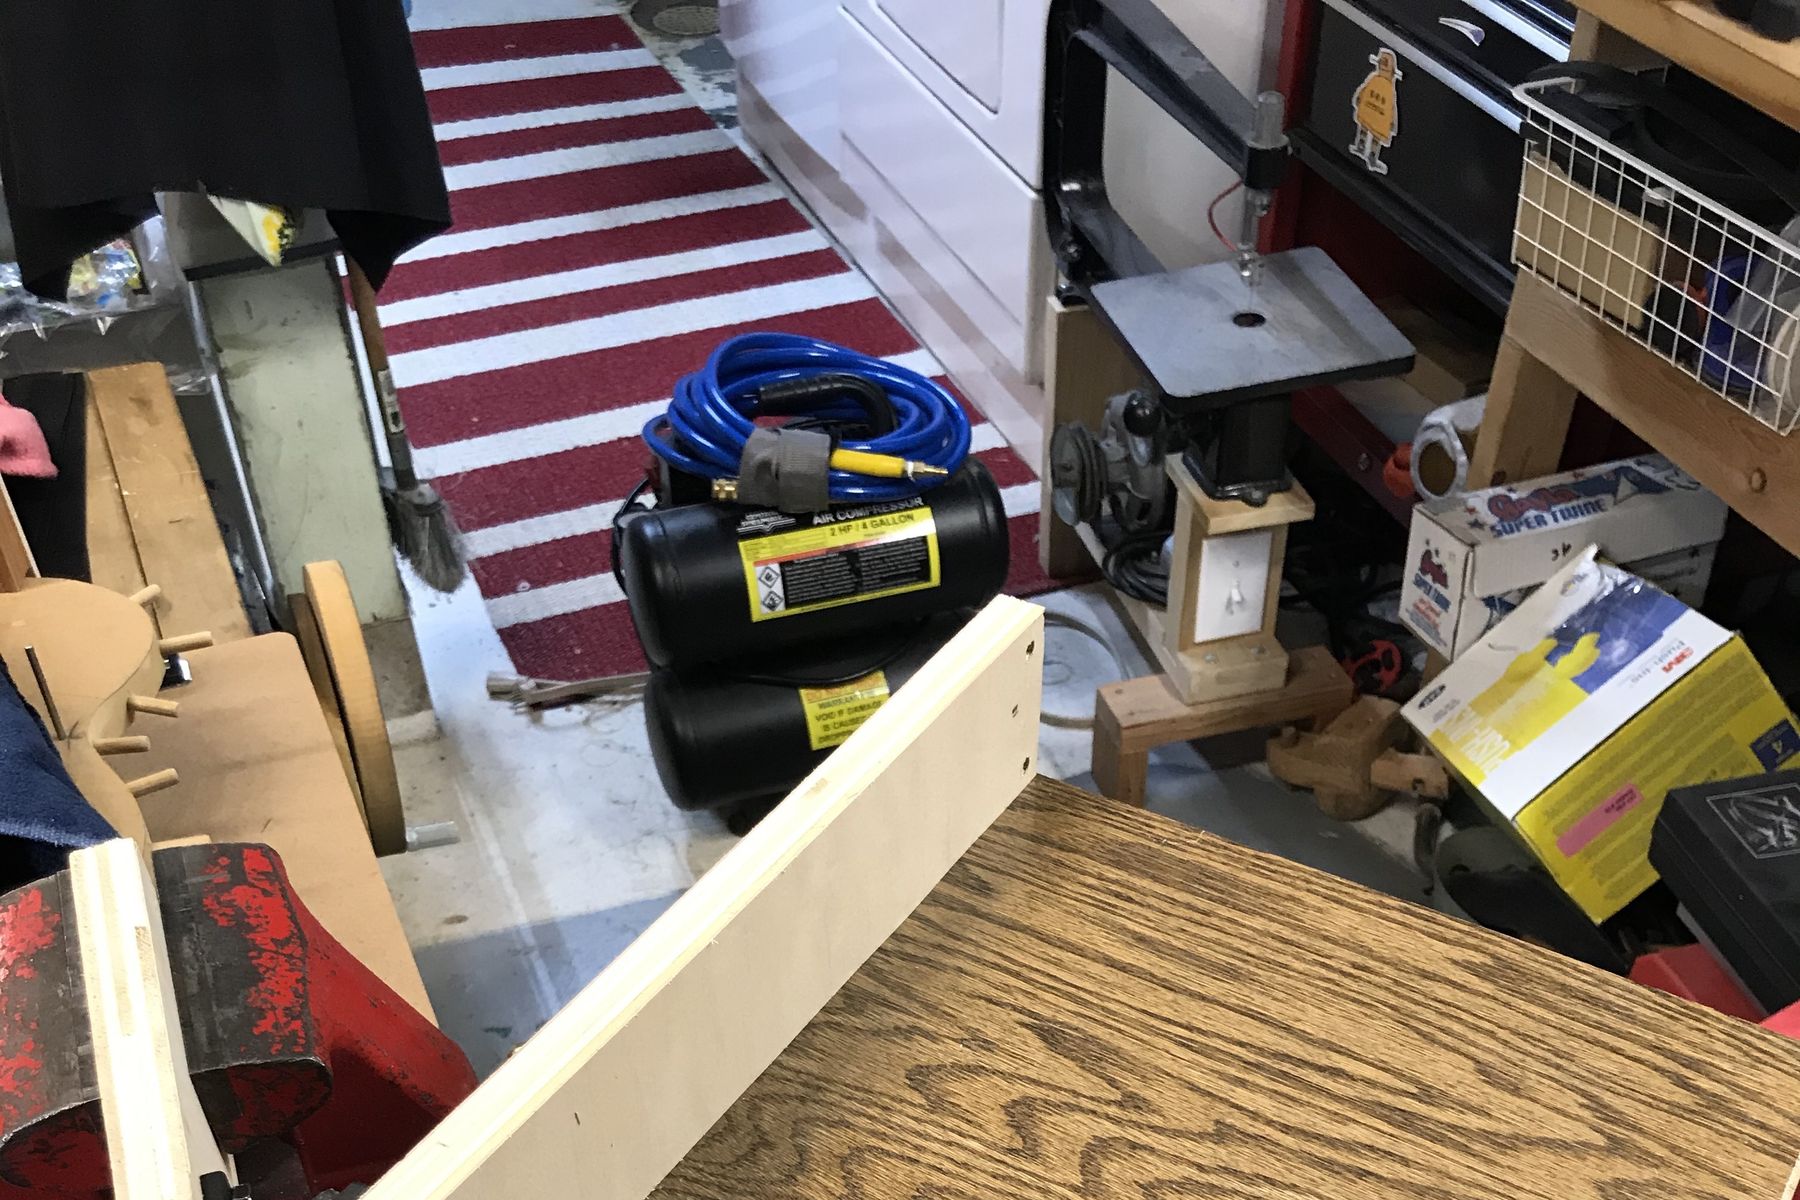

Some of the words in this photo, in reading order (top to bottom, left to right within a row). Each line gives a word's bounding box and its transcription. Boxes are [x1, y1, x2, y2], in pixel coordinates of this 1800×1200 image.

[812, 511, 835, 526] AIR
[835, 496, 925, 521] COMPRESSOR
[870, 512, 915, 530] GALLON
[1489, 513, 1548, 538] SUPER
[1552, 499, 1608, 524] TWINE
